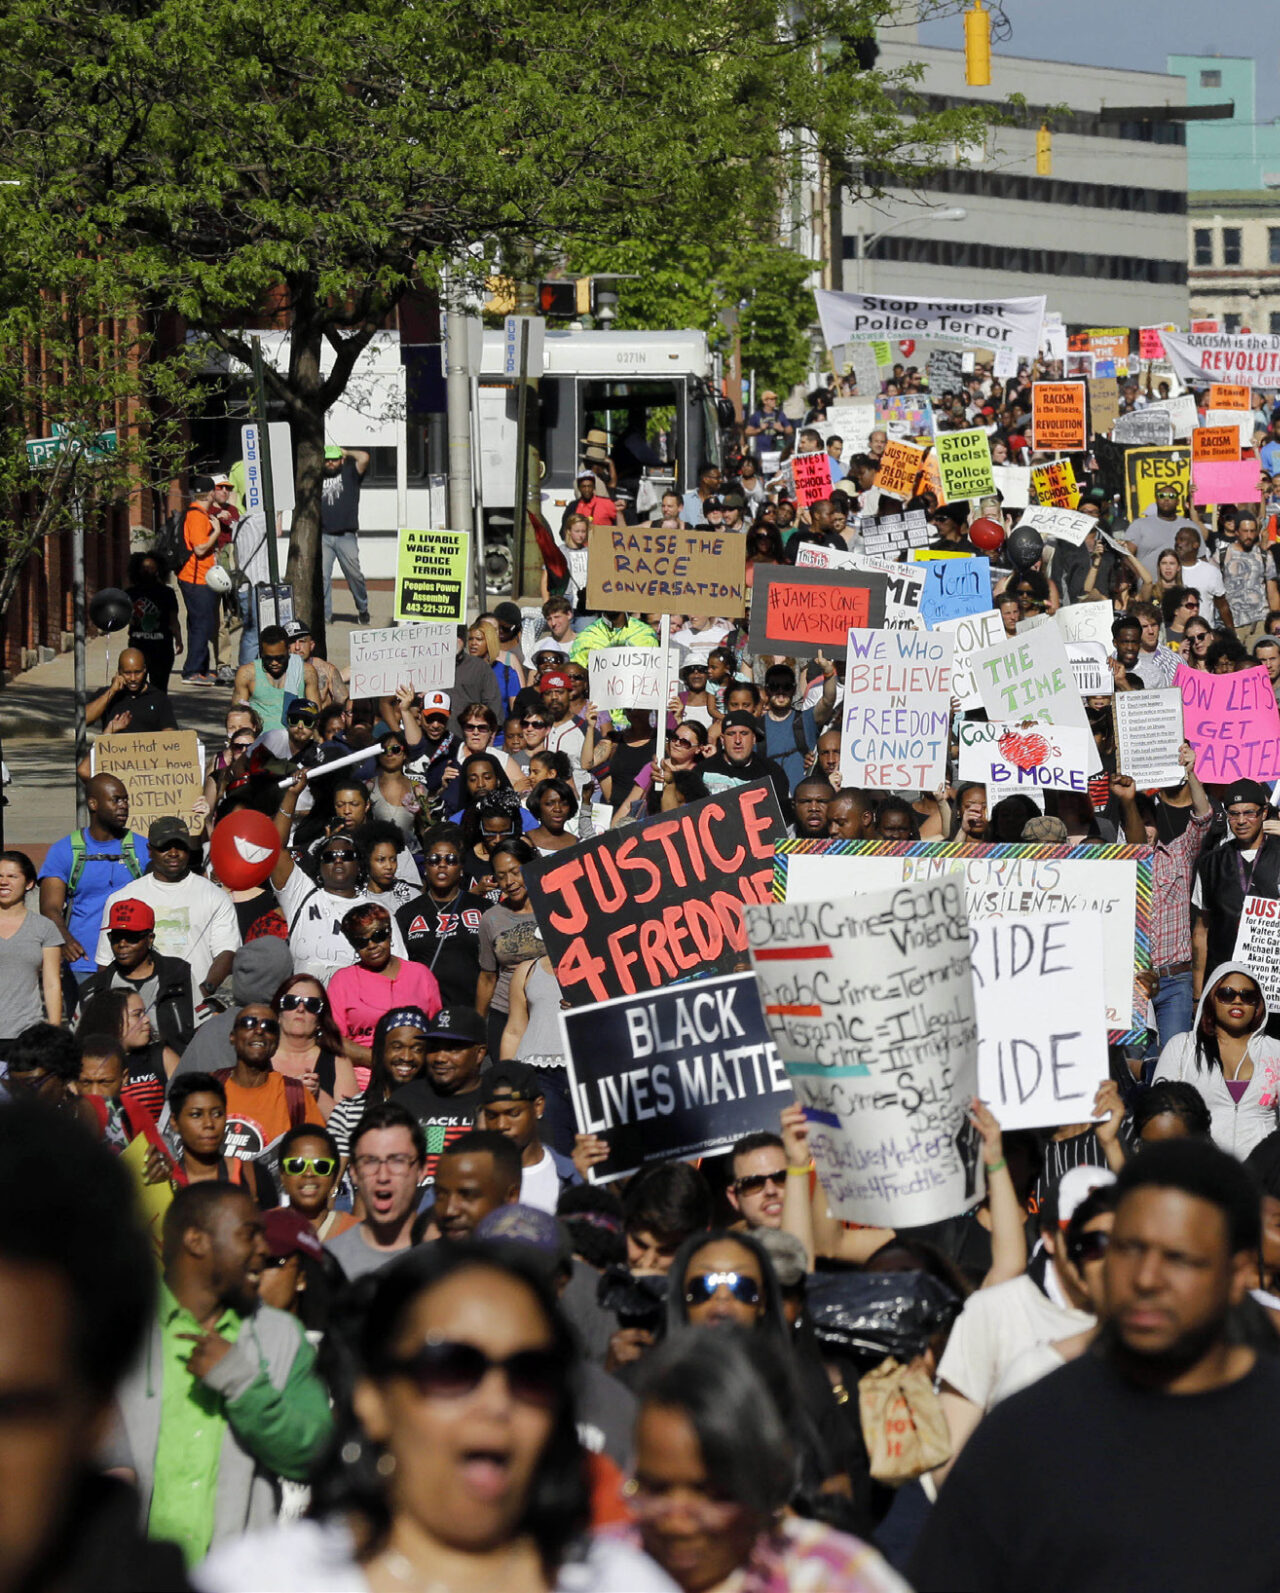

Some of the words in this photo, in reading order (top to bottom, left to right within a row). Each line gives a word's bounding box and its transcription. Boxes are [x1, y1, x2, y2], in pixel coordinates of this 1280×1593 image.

[863, 297, 918, 314] Stop
[855, 315, 928, 331] Police
[938, 315, 1012, 341] Terror
[1187, 335, 1231, 348] RACISM
[1234, 337, 1245, 348] is
[1247, 335, 1267, 349] the
[617, 353, 646, 363] 0271N
[1222, 373, 1231, 384] is
[1235, 373, 1253, 386] the
[1043, 393, 1074, 404] RACISM
[1217, 387, 1245, 397] Stand
[1036, 420, 1083, 429] REVOLUTION
[246, 429, 256, 461] BUS
[942, 434, 981, 451] STOP
[1201, 436, 1231, 447] RACISM
[795, 452, 826, 465] INVEST
[884, 449, 920, 466] JUSTICE
[892, 458, 905, 469] FOR
[941, 448, 988, 464] Racist
[806, 465, 816, 475] IN
[881, 464, 917, 484] FREDDIE
[945, 465, 990, 481] Police
[1034, 461, 1068, 477] INVEST
[248, 466, 260, 507] STOP
[795, 475, 832, 489] SCHOOLS
[881, 476, 906, 491] GRAY
[946, 477, 992, 492] Terror
[1048, 476, 1059, 487] IN
[805, 488, 823, 499] NOT
[1038, 483, 1077, 502] SCHOOLS
[1051, 498, 1070, 508] NOT
[1031, 513, 1089, 531] RACE
[408, 533, 416, 543] A
[419, 533, 459, 545] LIVABLE
[612, 531, 678, 555] RAISE
[686, 538, 725, 556] THE
[407, 544, 438, 555] WAGE
[440, 546, 460, 556] NOT
[415, 555, 450, 566] POLICE
[614, 555, 691, 577] RACE
[412, 566, 452, 577] TERROR
[404, 580, 434, 594] Peoples
[436, 582, 460, 594] Power
[413, 592, 450, 605] Assembly
[770, 588, 827, 609] #JAMES
[405, 602, 456, 616] 443-221-3775
[353, 629, 388, 645] LET'S
[390, 627, 420, 643] KEEP
[421, 625, 451, 640] THIS
[356, 645, 408, 663] JUSTICE
[411, 642, 450, 659] TRAIN
[896, 631, 943, 661] WHO
[593, 655, 608, 673] NO
[982, 643, 1034, 686] THE
[608, 674, 625, 696] NO
[850, 664, 951, 695] BELIEVE
[1000, 667, 1068, 712] TIME
[1172, 671, 1217, 711] NOW
[1226, 674, 1275, 712] LET'S
[890, 695, 907, 708] IN
[846, 706, 949, 737] FREEDOM
[1196, 720, 1253, 741] GET
[99, 740, 127, 756] Now
[132, 740, 158, 752] that
[163, 743, 181, 752] we
[850, 739, 942, 763] CANNOT
[101, 758, 159, 773] FINALLY
[166, 758, 192, 770] have
[129, 773, 199, 787] ATTENTION,
[864, 763, 933, 788] REST
[540, 787, 775, 935] JUSTICE
[903, 857, 1062, 891] DEMOCRATS
[744, 903, 817, 946] Black
[817, 902, 886, 940] Crime
[891, 882, 959, 926] Gang
[1246, 916, 1257, 925] for
[557, 936, 606, 1002] 4
[607, 868, 774, 994] FREDDIE
[1250, 926, 1275, 937] Walter
[1251, 935, 1265, 945] Eric
[1242, 942, 1274, 955] Michael
[1248, 953, 1265, 963] Akai
[812, 970, 890, 1008] Crime
[625, 986, 745, 1059] BLACK
[888, 995, 970, 1045] Illegal
[768, 1012, 874, 1049] Hispanic
[814, 1043, 878, 1067] Crime
[578, 1063, 676, 1134] LIVES
[677, 1041, 792, 1112] MATTE
